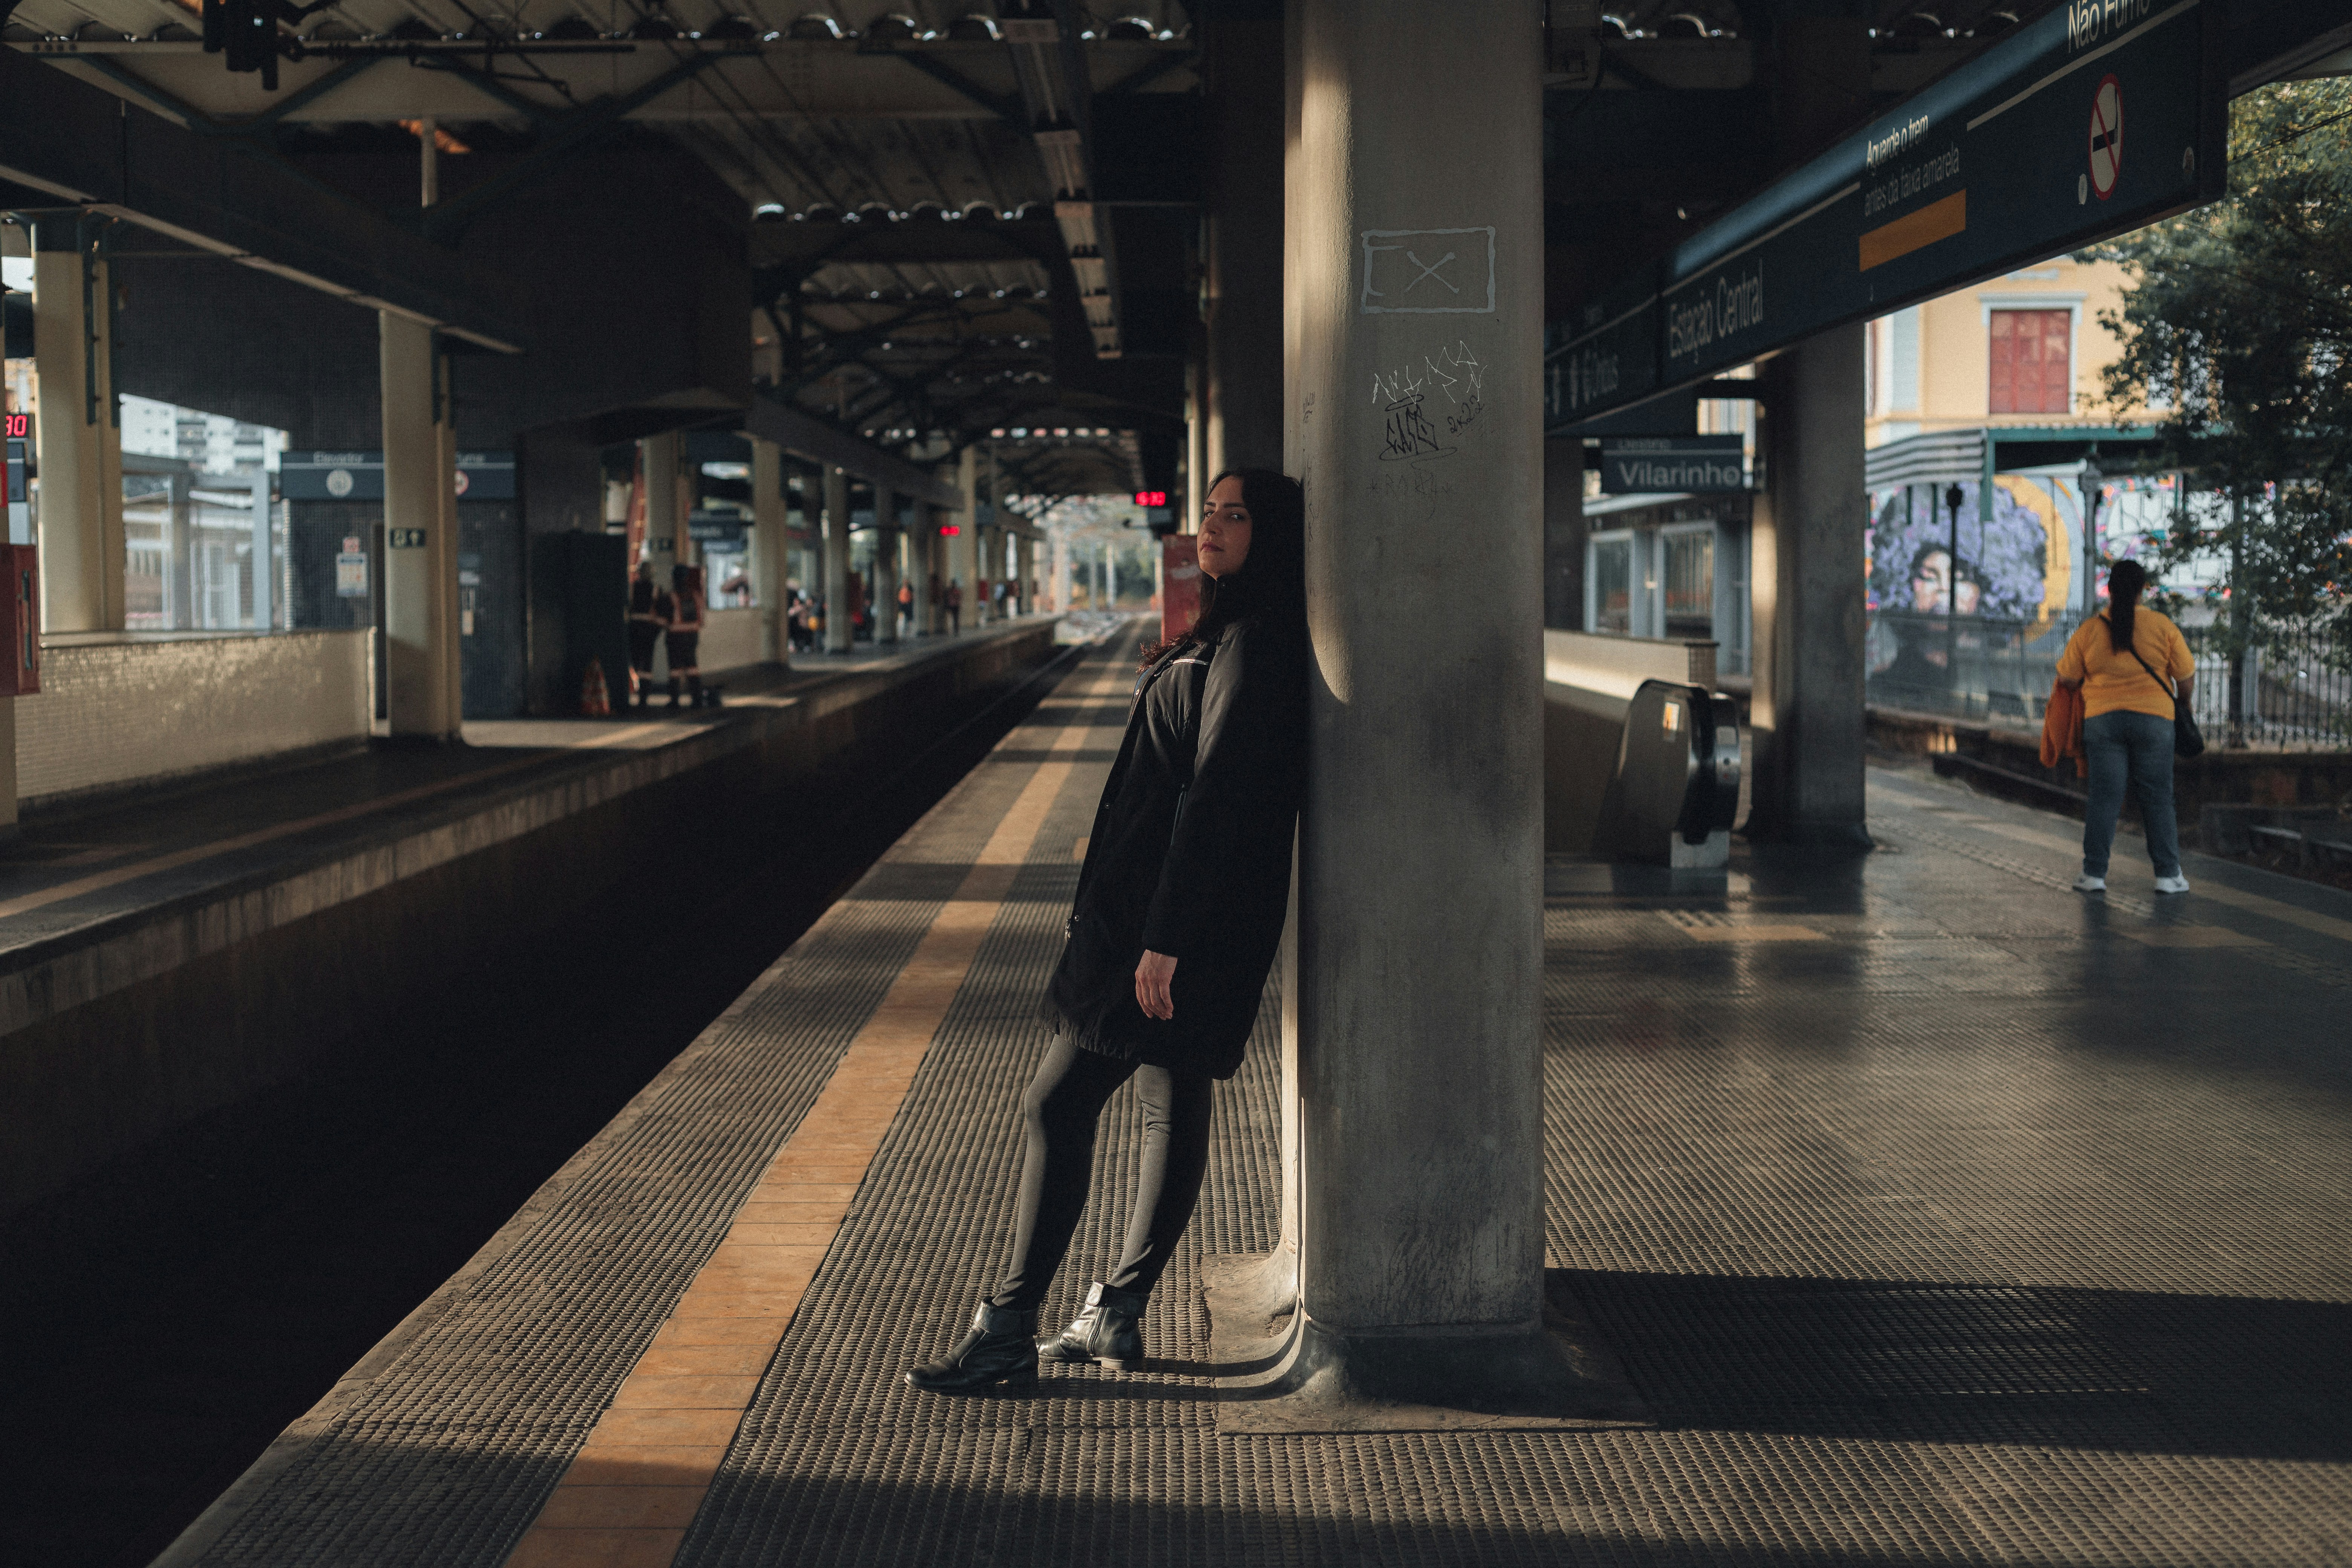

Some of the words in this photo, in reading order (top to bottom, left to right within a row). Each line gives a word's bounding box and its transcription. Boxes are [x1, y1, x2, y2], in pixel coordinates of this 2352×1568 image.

[2068, 0, 2100, 54] Não
[1866, 127, 1900, 176] Aguarde
[1901, 127, 1907, 152] o
[1908, 114, 1929, 148] trem
[1888, 172, 1899, 205] da
[1900, 164, 1921, 198] faixa
[1922, 142, 1959, 188] amarela
[1669, 289, 1713, 365] Estação
[1717, 258, 1764, 338] Central
[1618, 459, 1741, 488] Vilarinho
